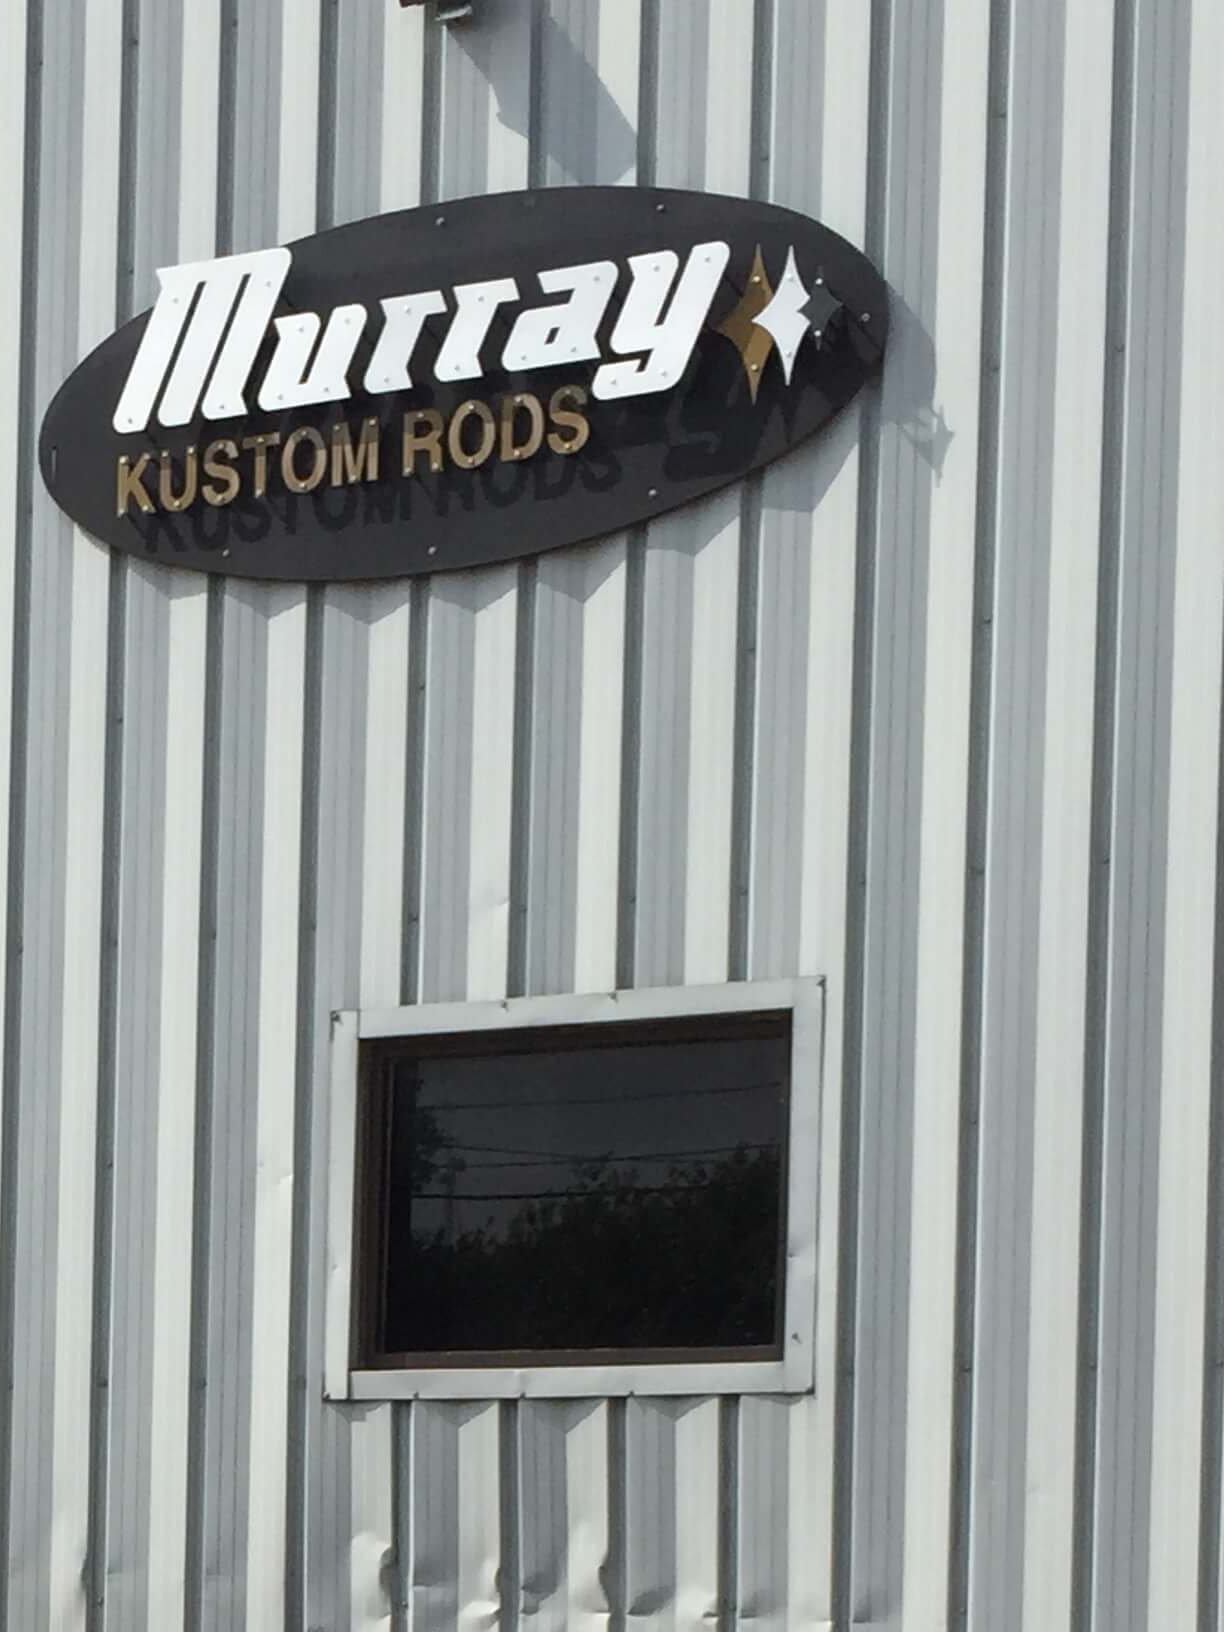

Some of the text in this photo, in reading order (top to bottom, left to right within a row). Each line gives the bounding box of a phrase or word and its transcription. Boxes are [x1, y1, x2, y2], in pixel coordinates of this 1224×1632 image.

[112, 241, 730, 434] Murray
[116, 385, 592, 518] KUSTOM RODS
